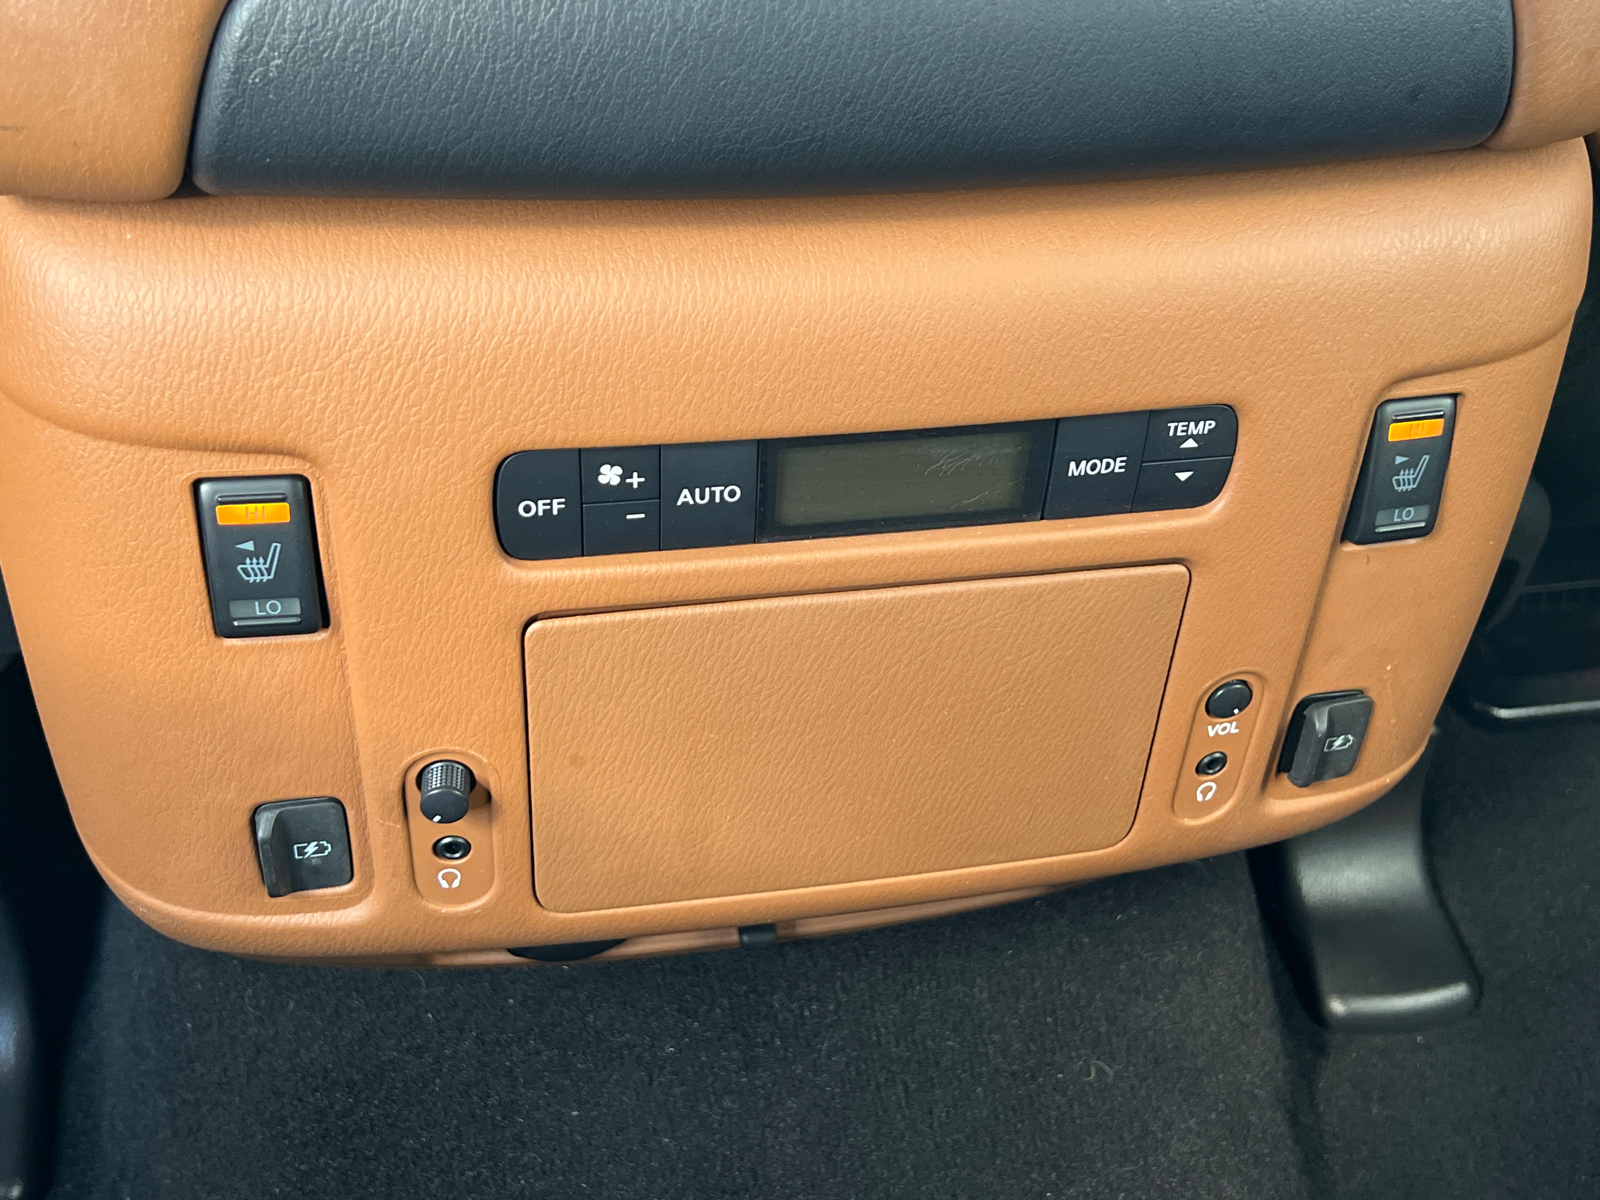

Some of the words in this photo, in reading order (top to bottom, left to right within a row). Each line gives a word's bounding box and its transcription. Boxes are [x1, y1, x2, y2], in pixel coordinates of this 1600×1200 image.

[1167, 420, 1216, 437] TEMP
[1410, 422, 1426, 437] HI
[1067, 456, 1127, 477] MODE
[676, 485, 741, 506] AUTO
[245, 505, 267, 521] HI
[517, 498, 566, 518] OFF
[1393, 507, 1414, 522] LO
[254, 600, 282, 616] LO
[1207, 721, 1240, 738] VOL
